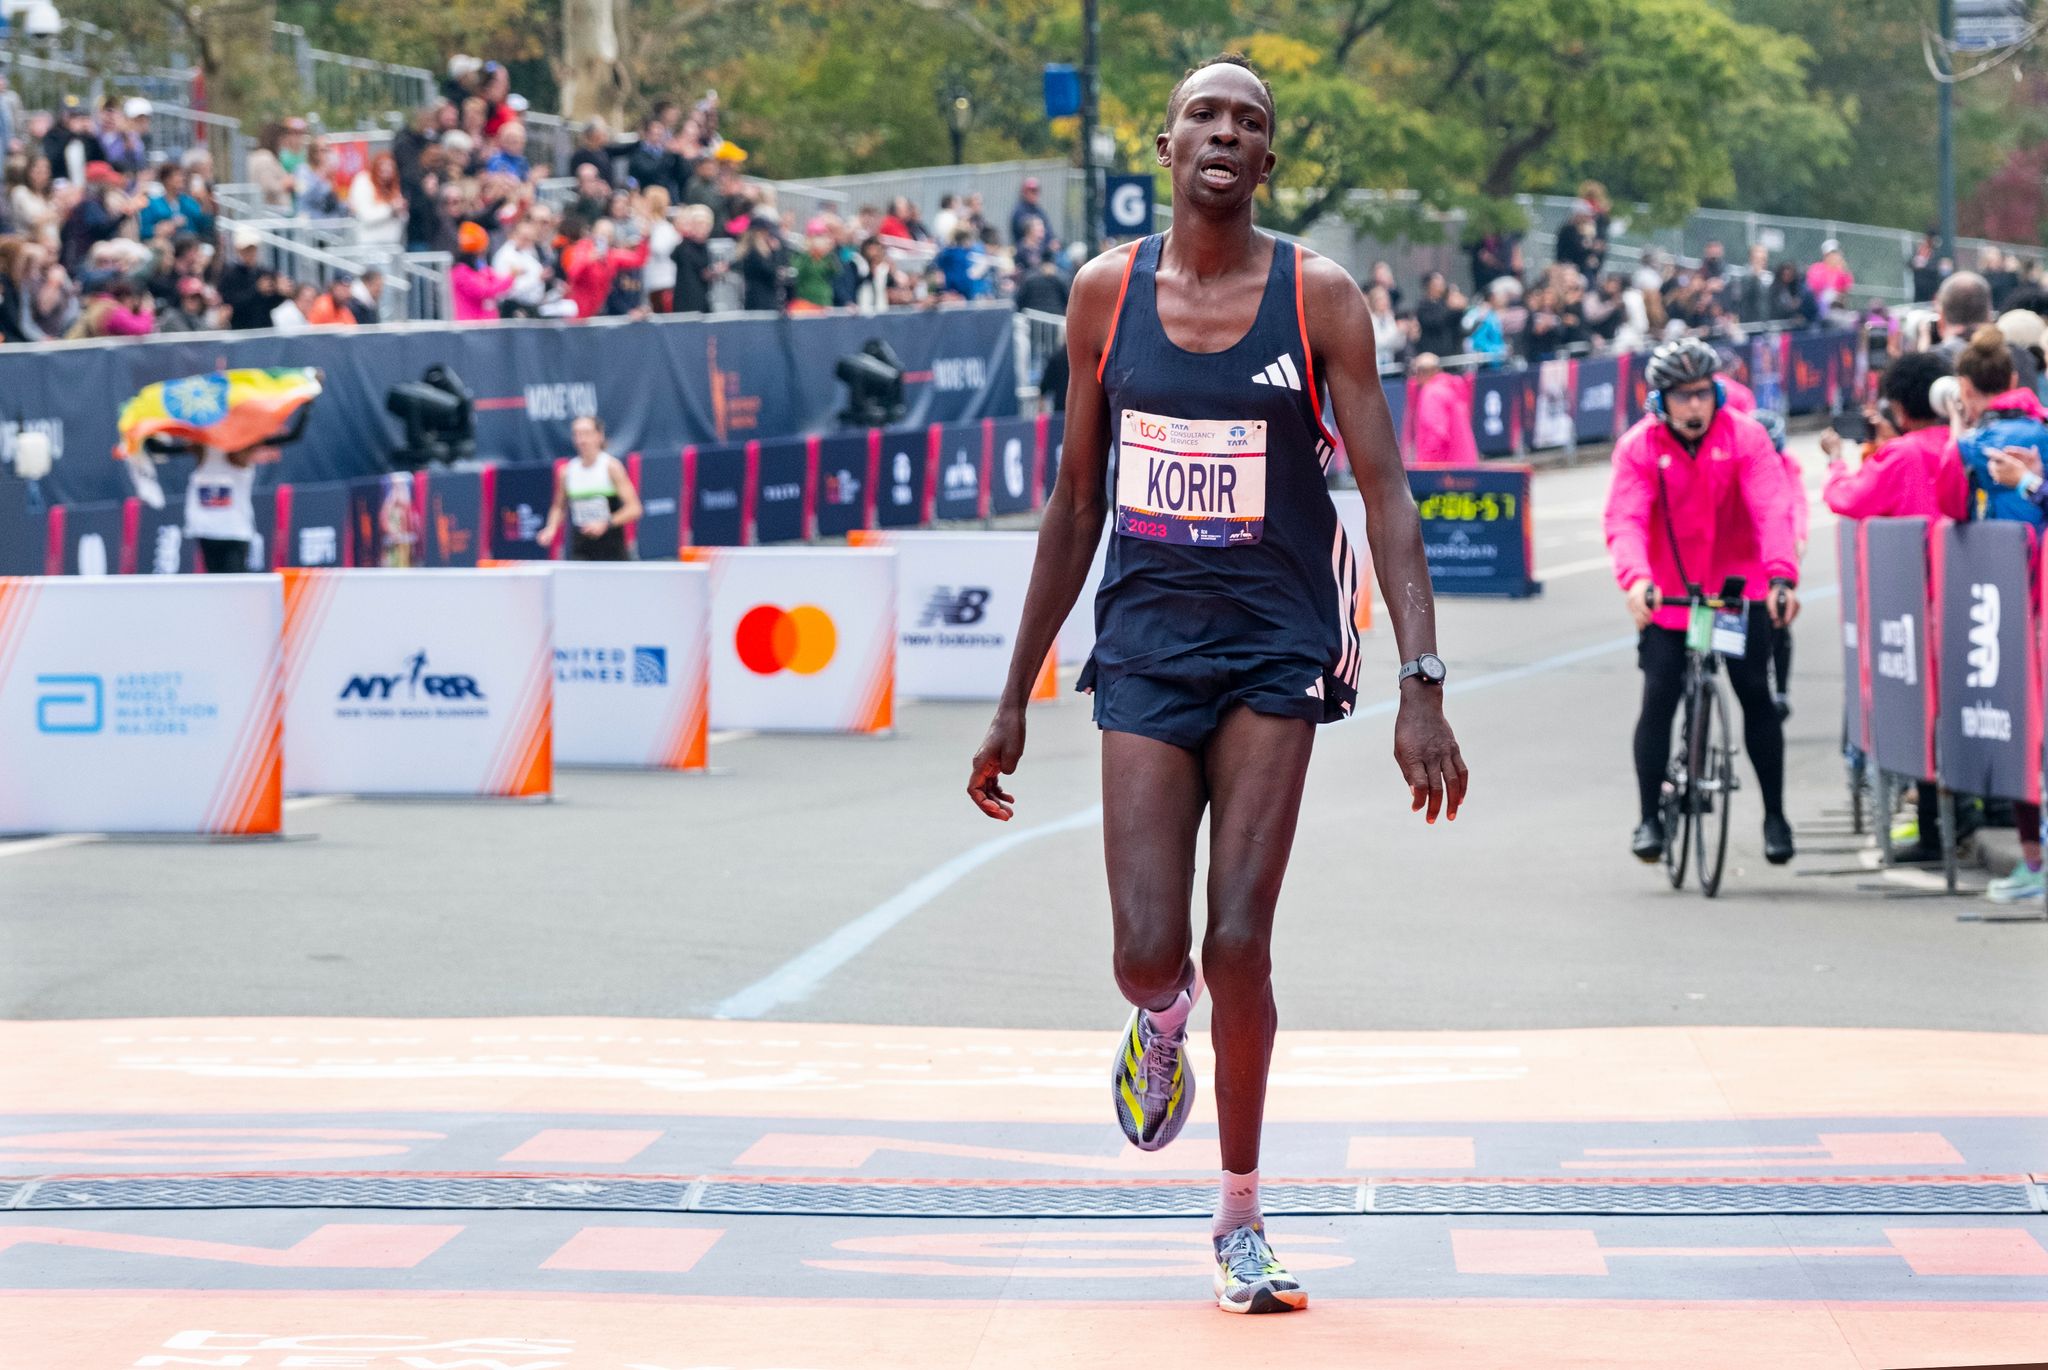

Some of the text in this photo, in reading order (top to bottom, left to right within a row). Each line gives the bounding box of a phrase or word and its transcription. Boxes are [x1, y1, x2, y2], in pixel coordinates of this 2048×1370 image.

[1111, 183, 1147, 227] G
[1139, 418, 1167, 442] tcs
[1170, 430, 1216, 439] CONSULTANCY
[1171, 423, 1189, 431] TATA
[1170, 437, 1199, 446] SERVICES
[1147, 457, 1237, 514] KORIR
[1128, 518, 1167, 538] 2023
[554, 648, 626, 663] NITED
[556, 667, 626, 683] LINES
